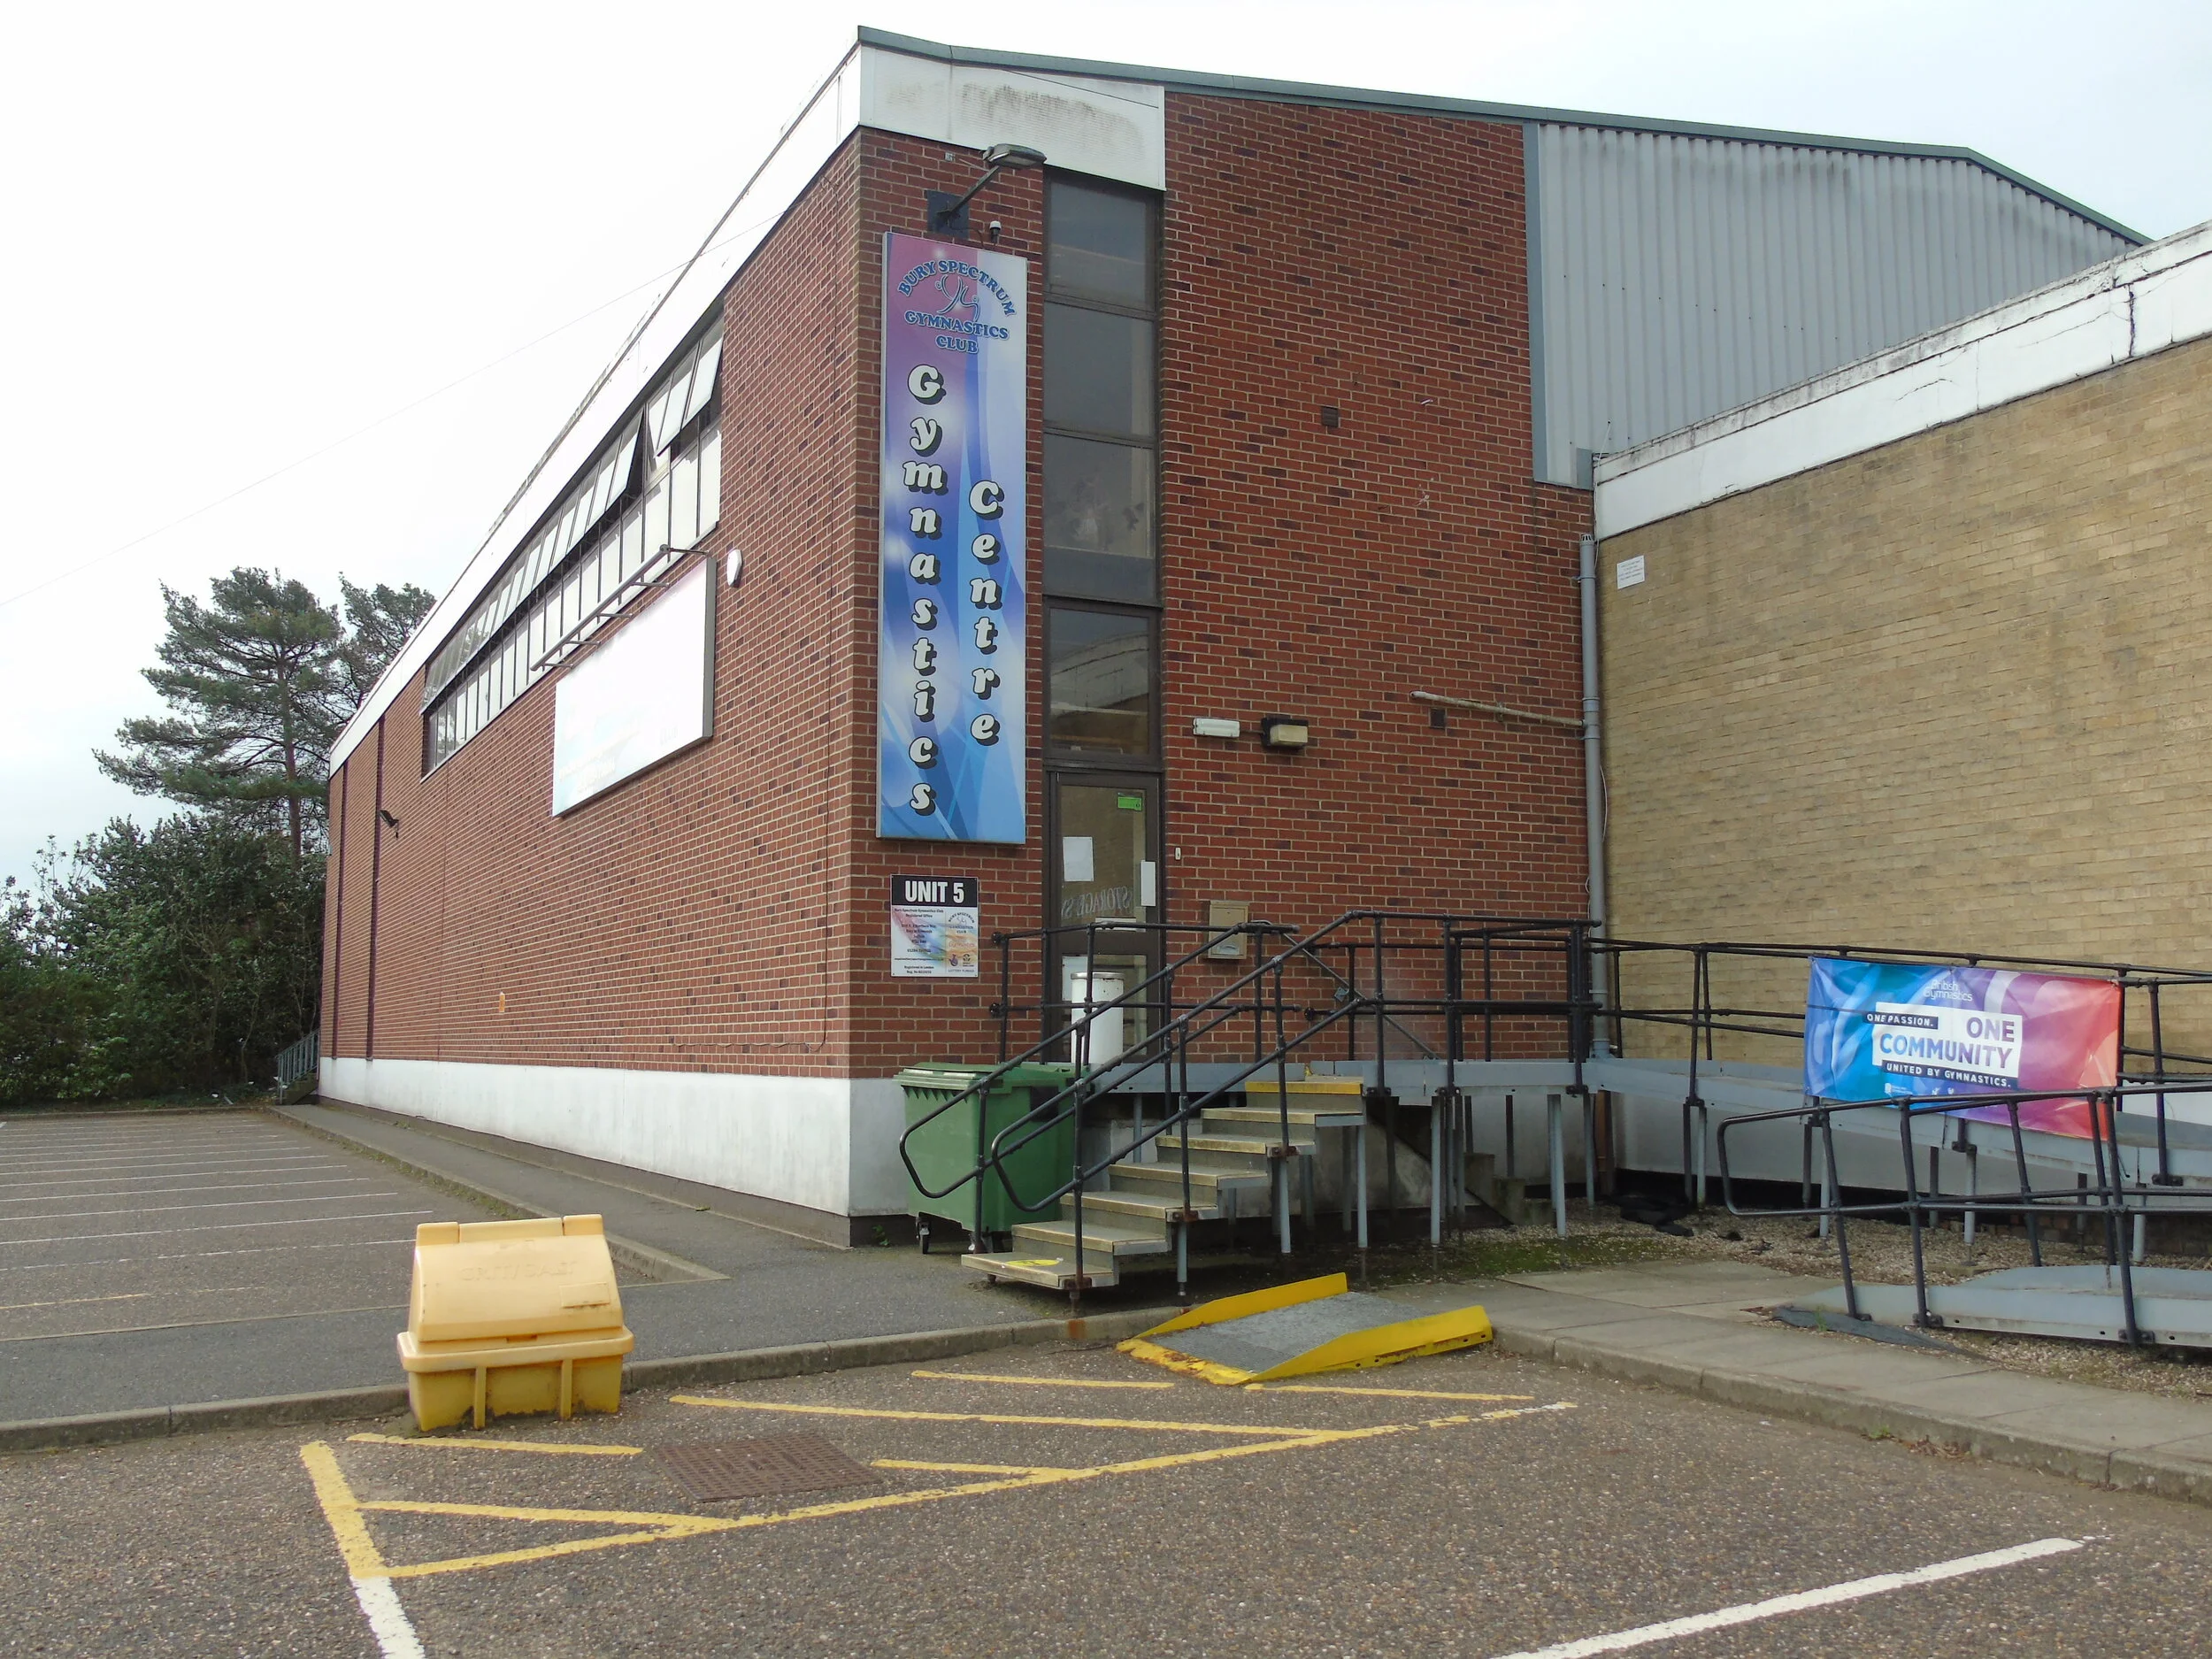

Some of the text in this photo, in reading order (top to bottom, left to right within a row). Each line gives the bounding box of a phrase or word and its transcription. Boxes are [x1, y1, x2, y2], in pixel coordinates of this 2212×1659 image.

[898, 260, 1017, 316] BURY SPECTRUM
[904, 311, 1010, 340] GYMNASTICS
[936, 335, 979, 353] CLUB
[902, 364, 947, 814] Gymnastics
[969, 480, 1003, 745] Centre
[905, 880, 964, 903] UNIT 5
[1867, 1014, 1933, 1026] ONE PASSION.
[1967, 1017, 2015, 1042] ONE
[1880, 1033, 2013, 1069] COMMUNITY
[1886, 1063, 2011, 1087] UNITED BY GYMNASTICS.
